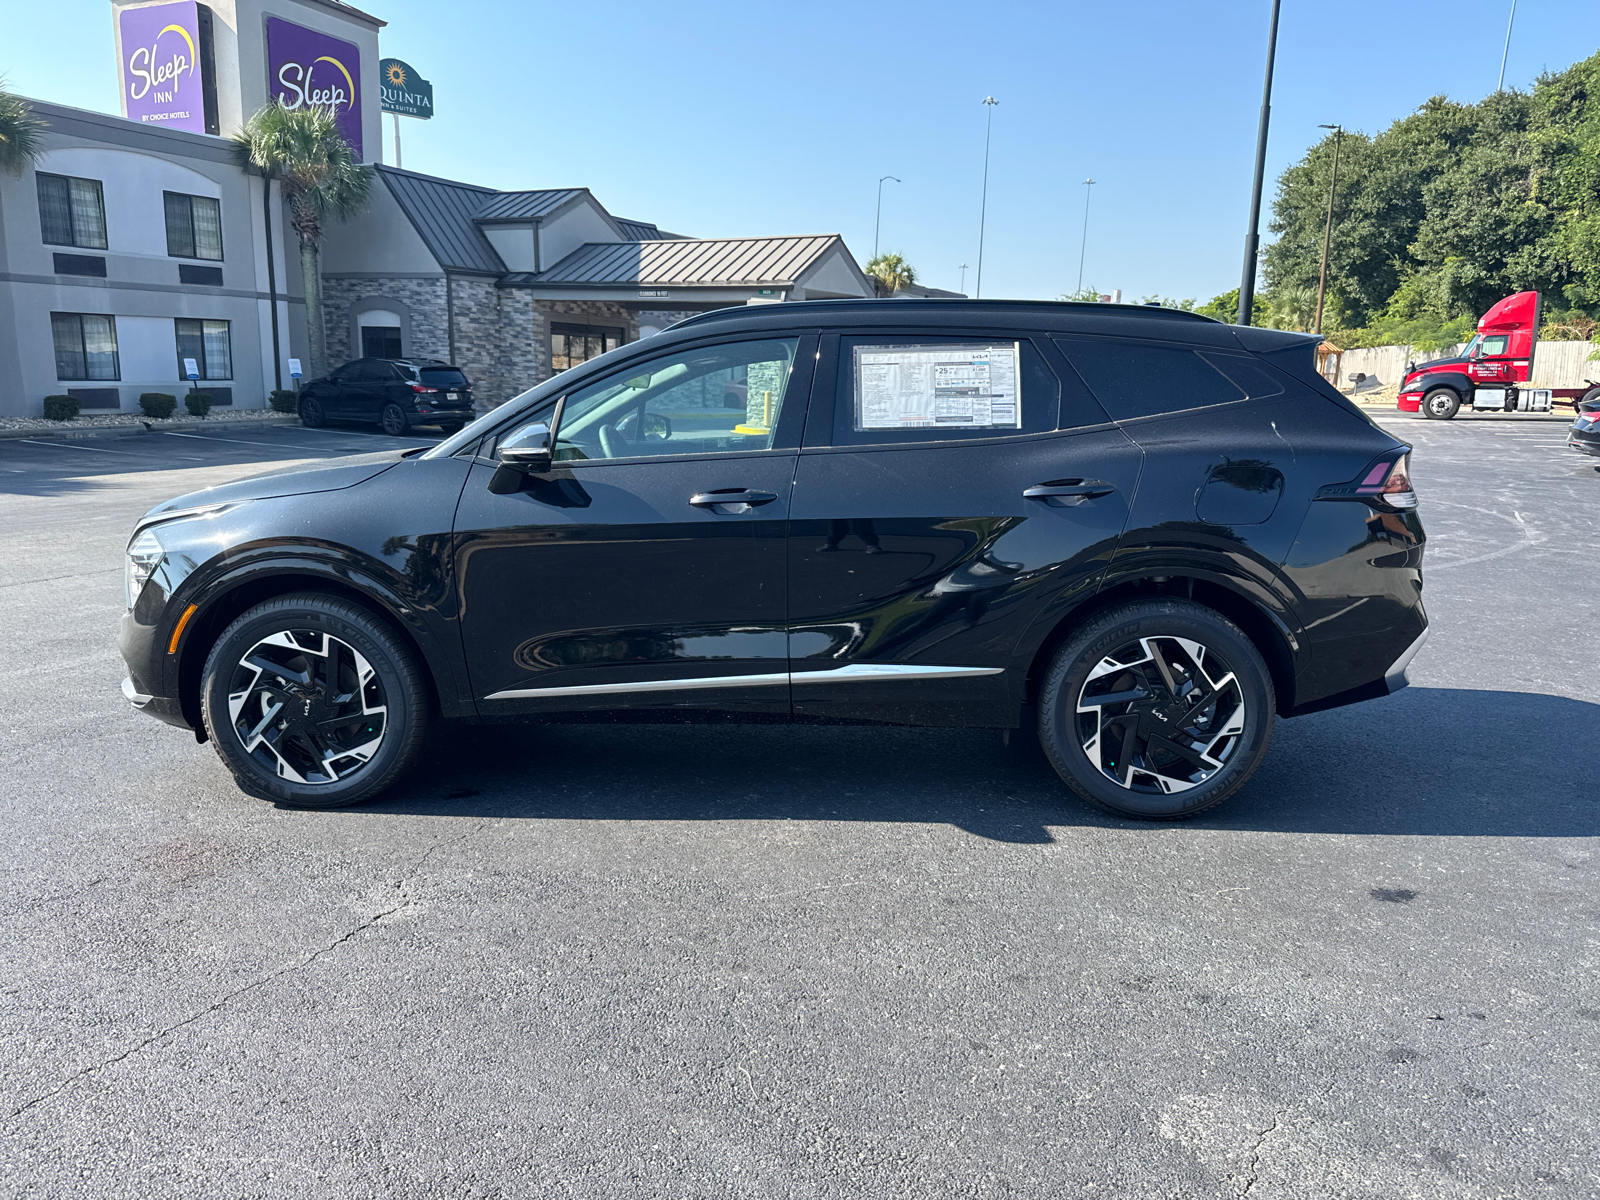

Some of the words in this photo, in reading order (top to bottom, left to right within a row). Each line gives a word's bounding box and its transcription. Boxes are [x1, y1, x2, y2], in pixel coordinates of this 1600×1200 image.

[129, 44, 189, 100] Sleep
[153, 91, 173, 104] INN
[279, 62, 348, 117] Sleep
[380, 85, 431, 108] QUINTA
[142, 114, 149, 122] BY
[149, 112, 169, 121] CHOICE
[169, 110, 190, 120] HOTELS
[395, 104, 418, 114] SUITES
[939, 367, 949, 375] 25
[344, 627, 391, 673] MICHELIN
[1084, 623, 1139, 661] MICHELIN
